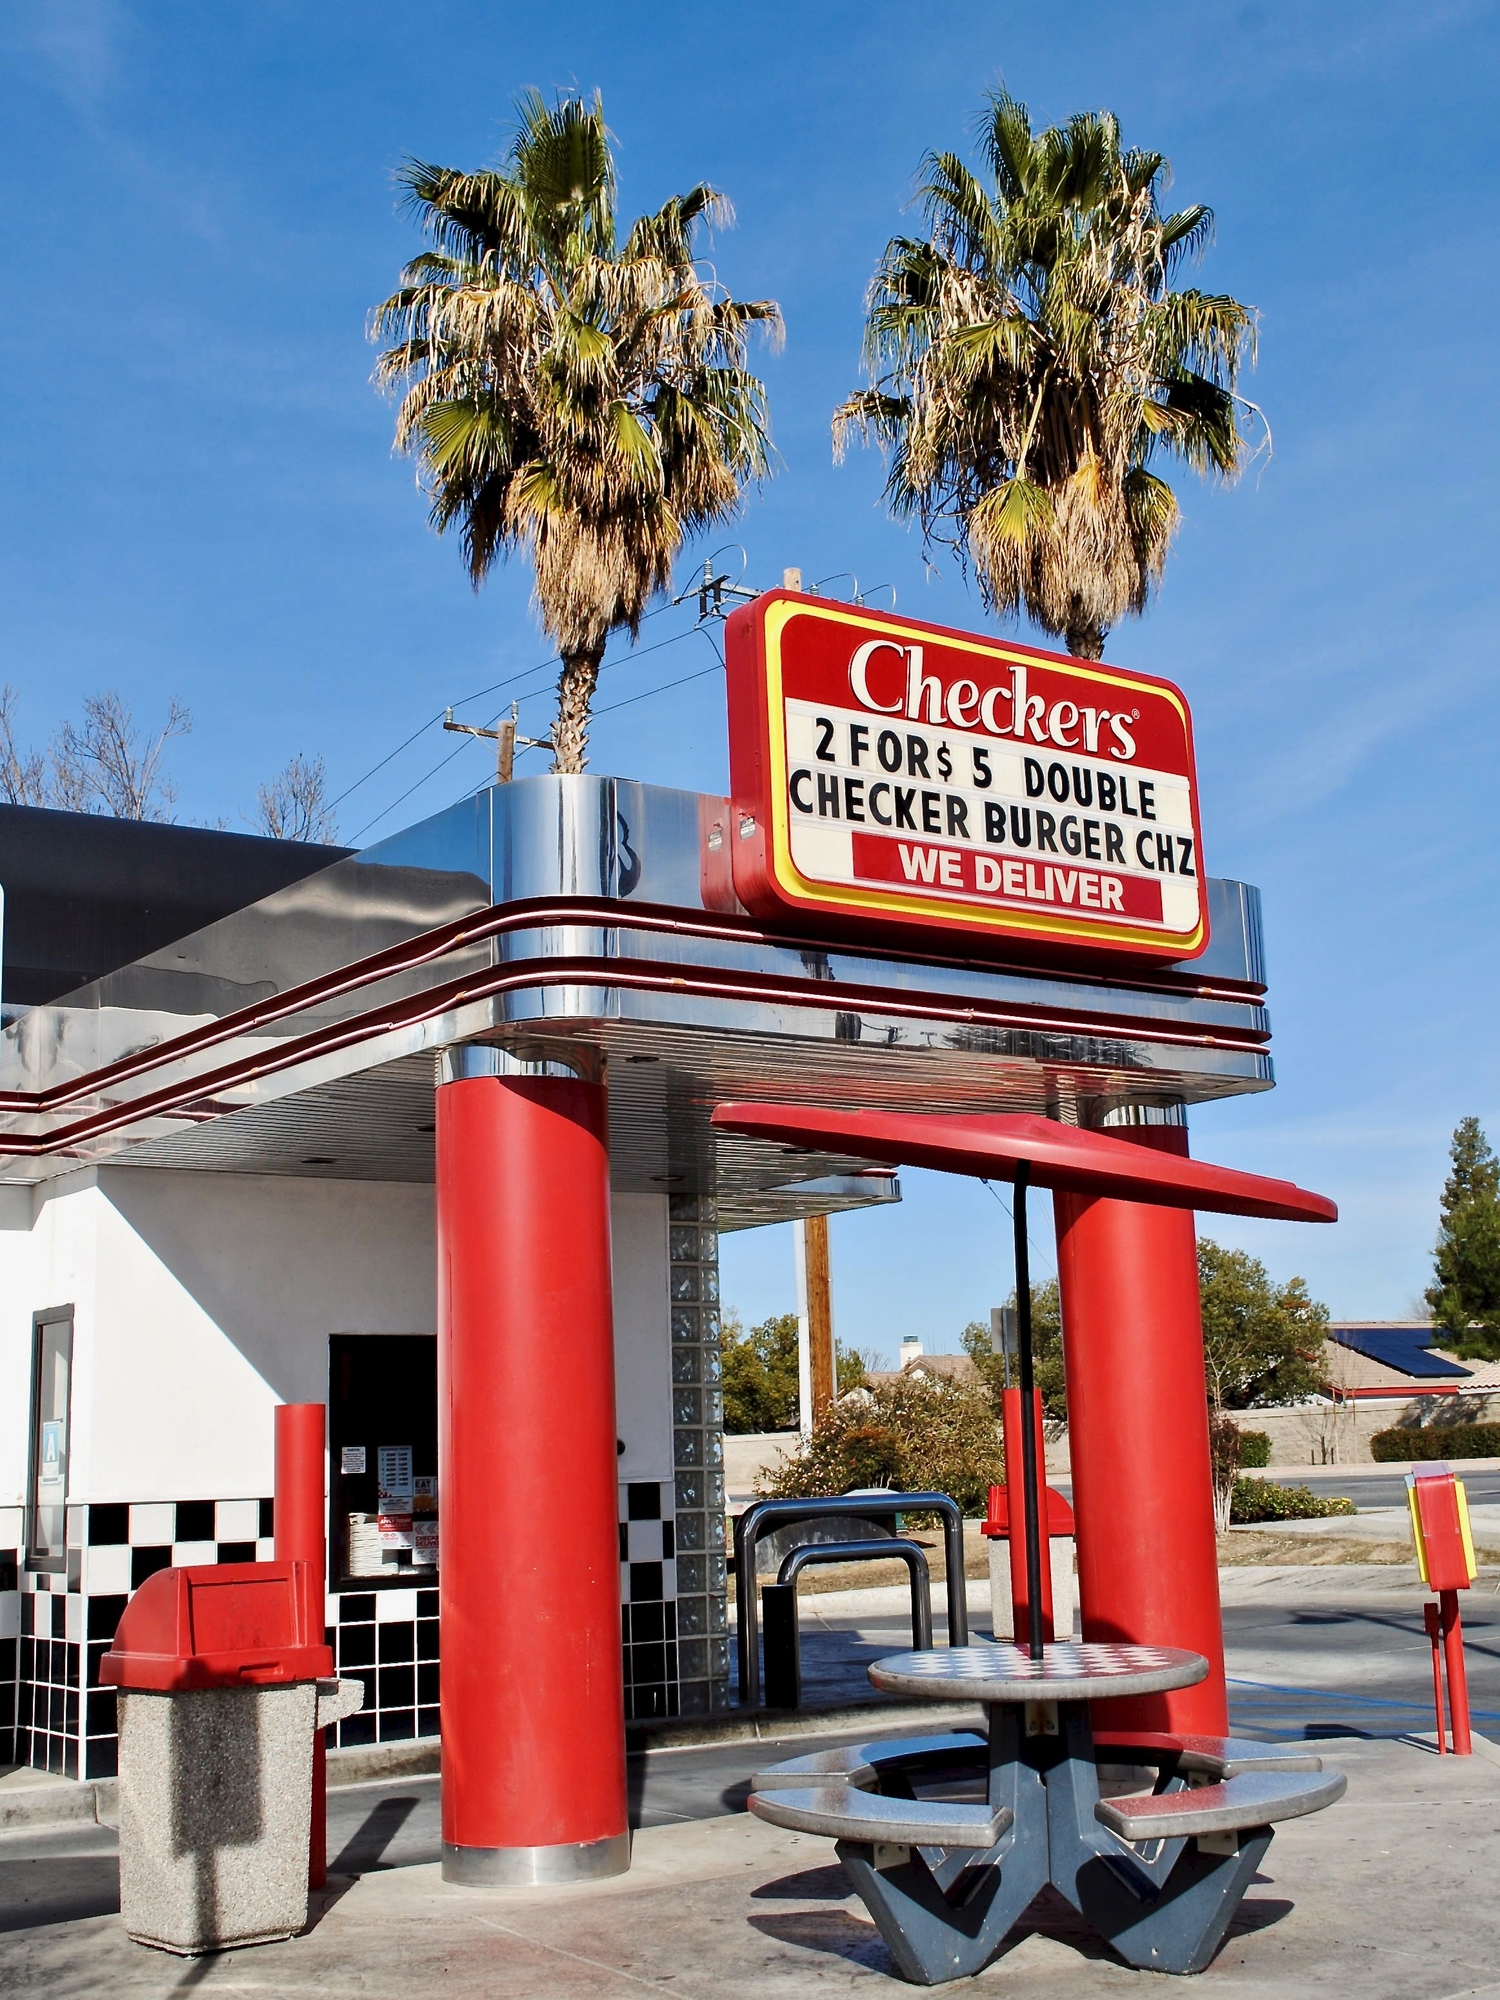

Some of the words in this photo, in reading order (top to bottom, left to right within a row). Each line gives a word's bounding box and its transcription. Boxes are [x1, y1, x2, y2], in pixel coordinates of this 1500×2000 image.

[815, 716, 836, 762] 2
[1023, 756, 1157, 821] DOUBLE
[789, 768, 971, 839] CHECKER
[984, 800, 1127, 864] BURGER
[1135, 829, 1196, 877] CHZ
[897, 843, 964, 888] WE
[974, 854, 1125, 912] DELIVER
[46, 1432, 56, 1462] A
